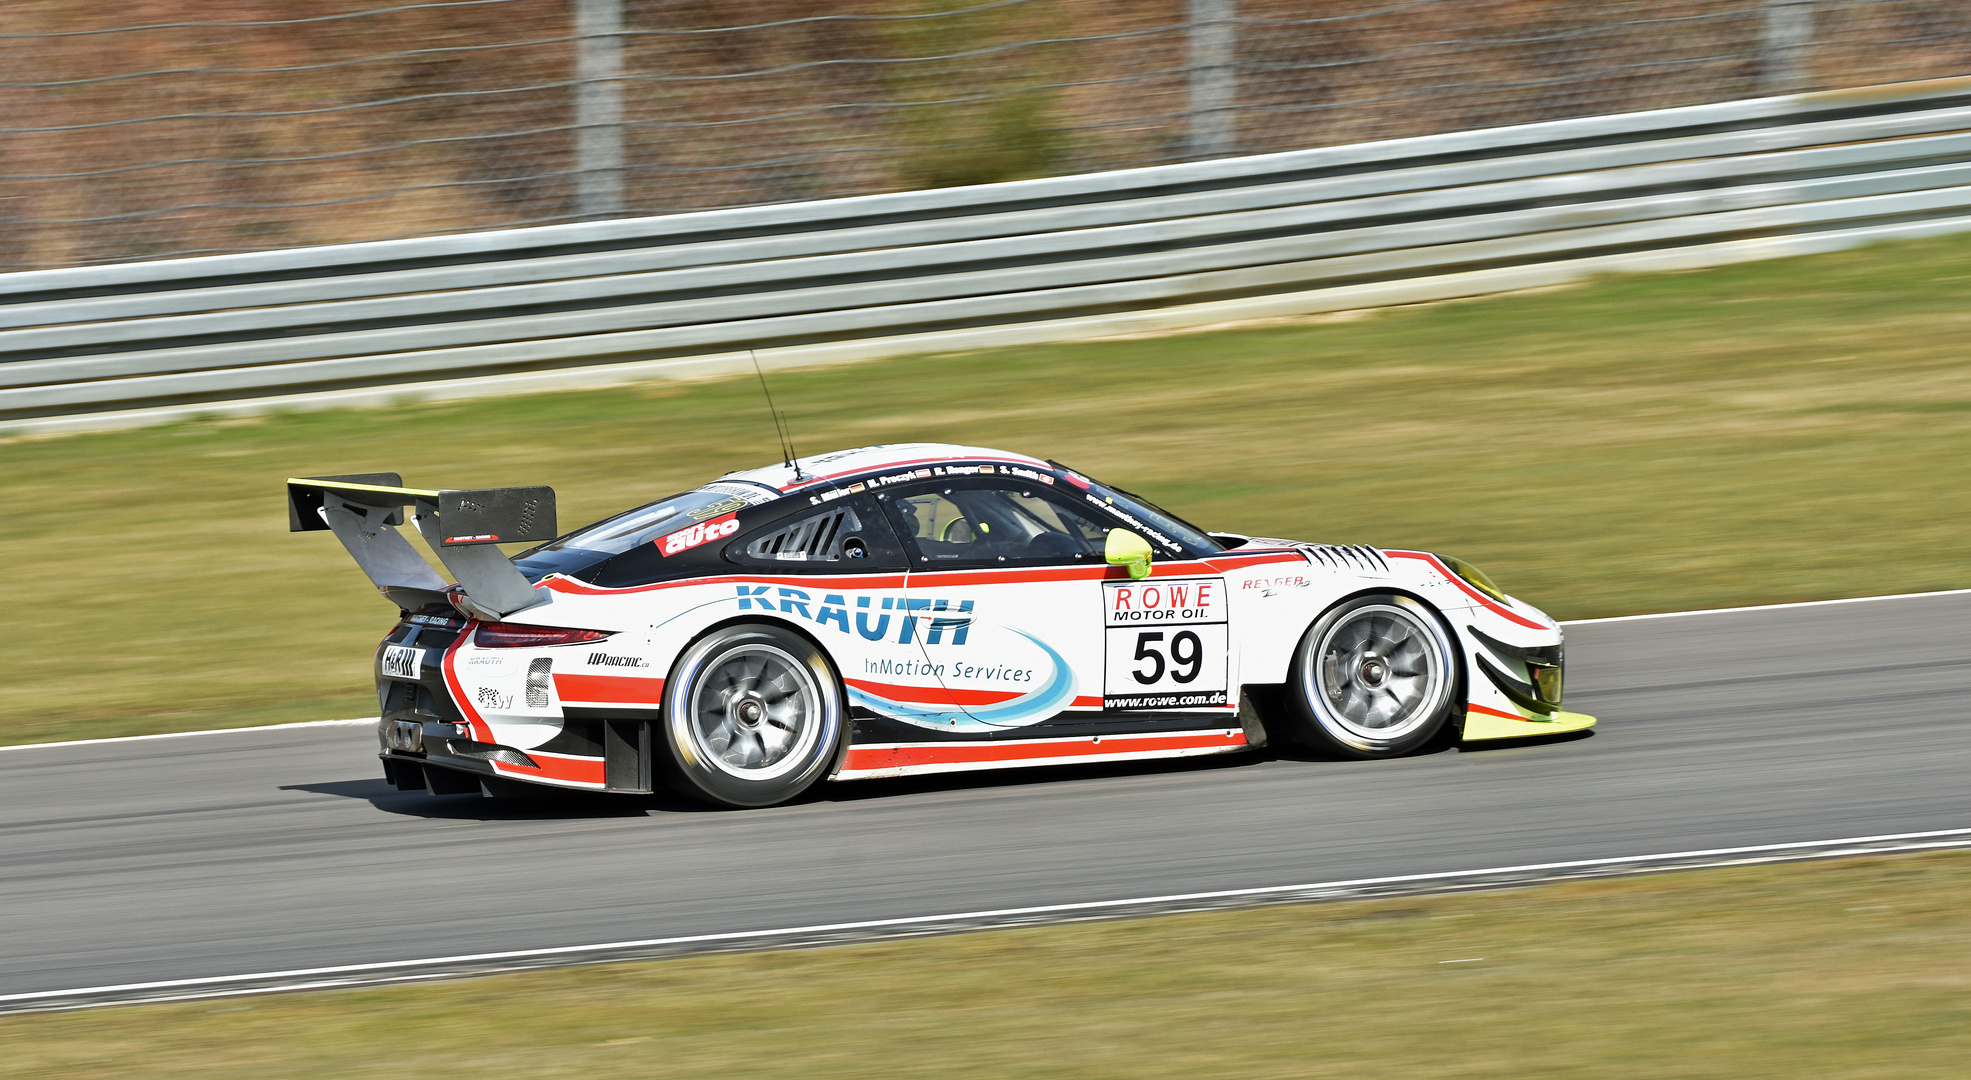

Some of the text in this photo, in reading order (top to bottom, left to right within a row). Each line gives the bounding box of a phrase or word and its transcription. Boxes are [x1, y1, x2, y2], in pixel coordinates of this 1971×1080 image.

[1000, 465, 1010, 475] S.
[809, 496, 821, 505] S.
[665, 519, 740, 554] auto
[1115, 585, 1212, 610] ROWE
[735, 585, 975, 645] KRAUTH
[1114, 610, 1175, 621] MOTOR
[864, 657, 1033, 683] InMotion Services
[1132, 630, 1203, 685] 59
[1104, 692, 1227, 708] www.rowe.com.de
